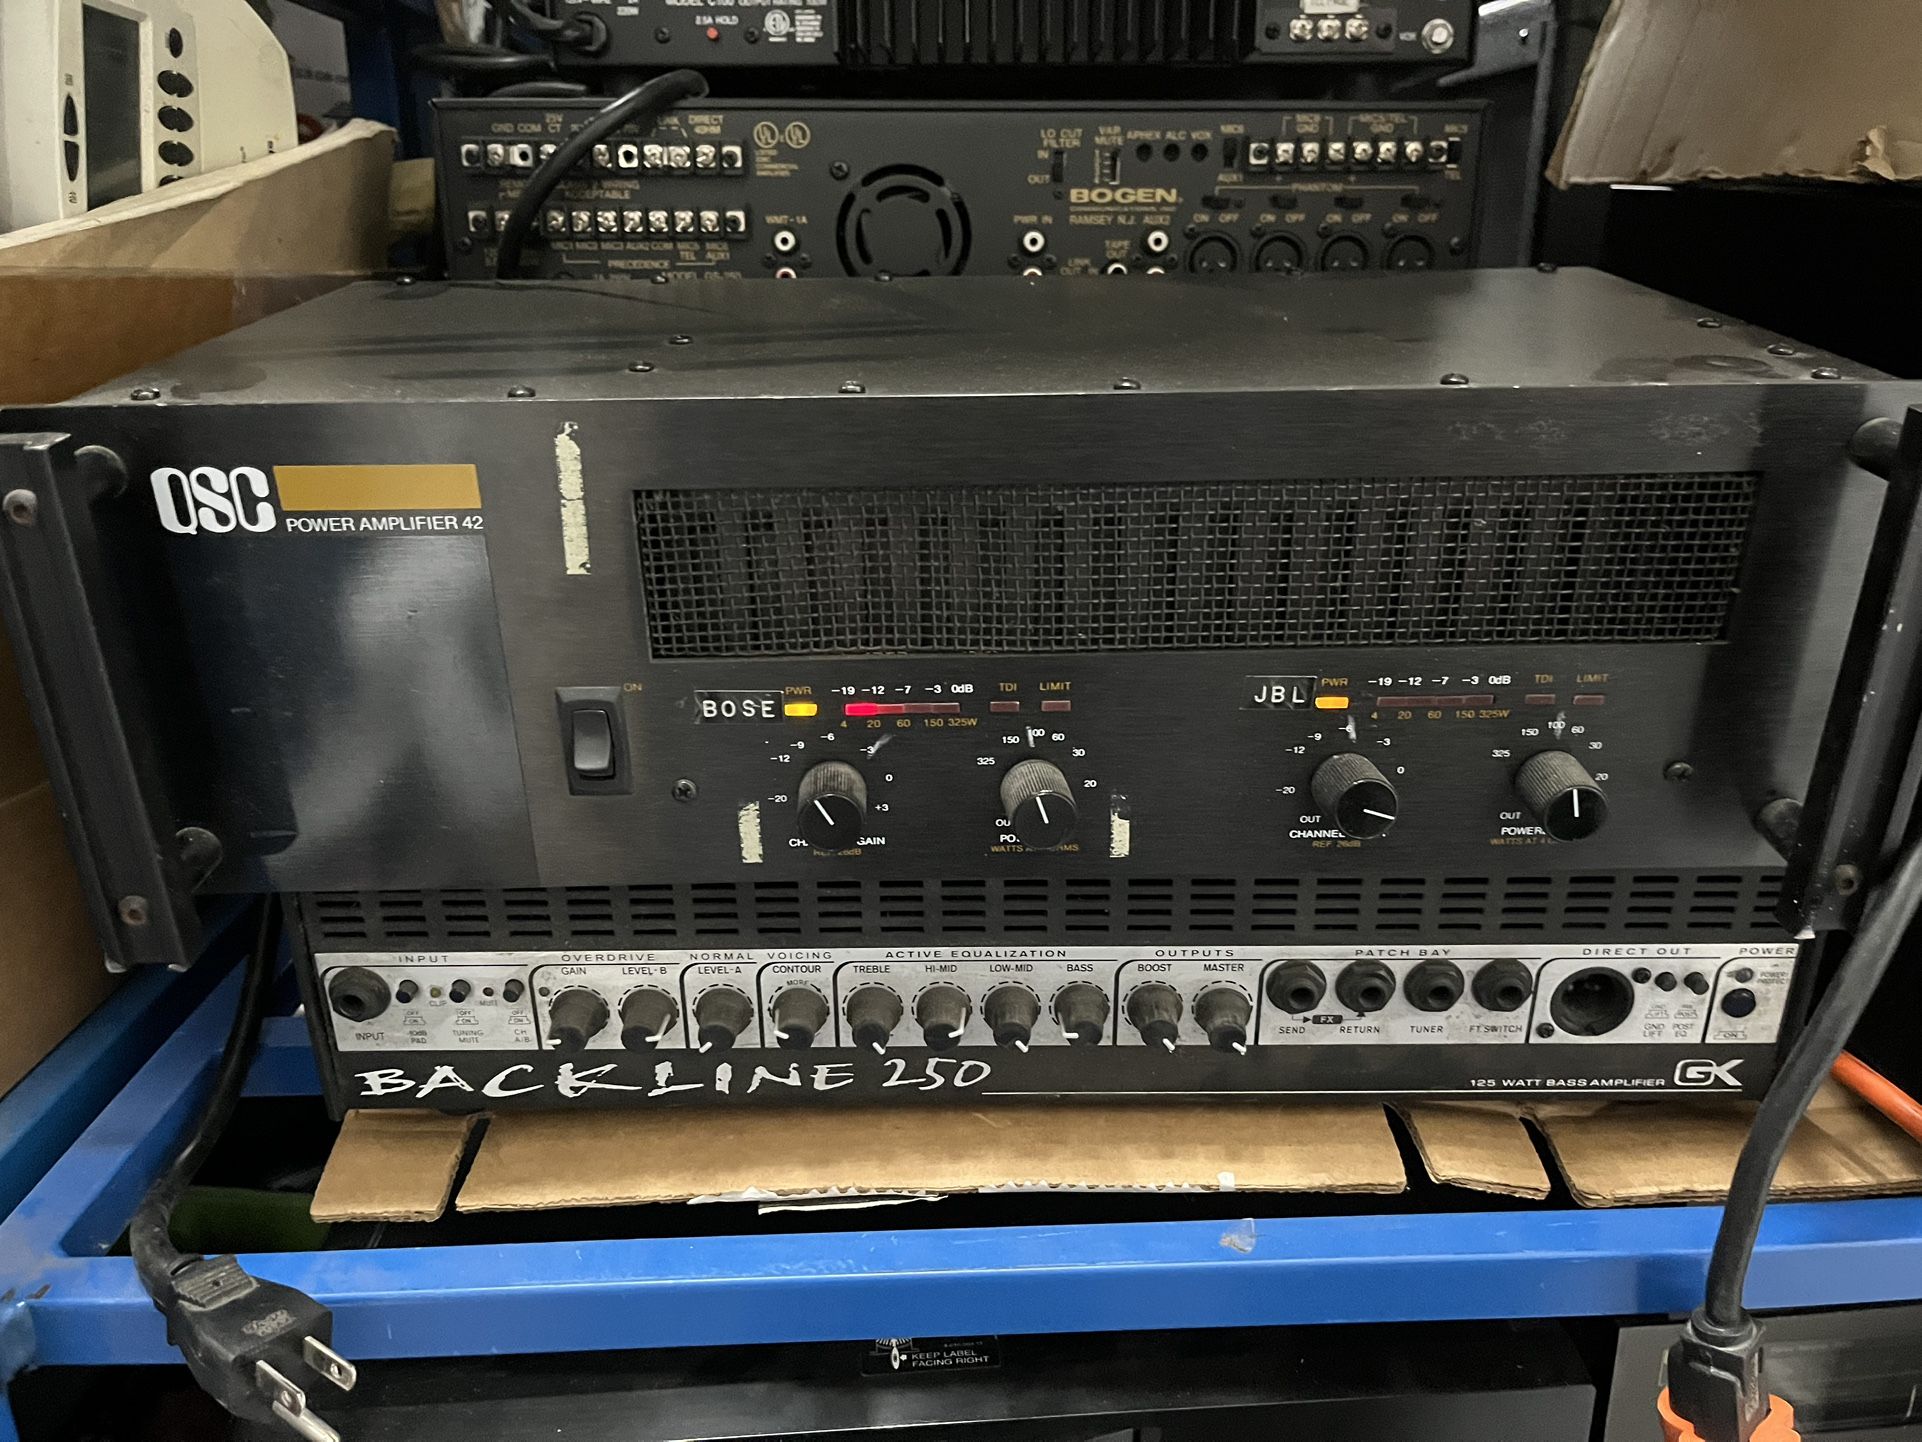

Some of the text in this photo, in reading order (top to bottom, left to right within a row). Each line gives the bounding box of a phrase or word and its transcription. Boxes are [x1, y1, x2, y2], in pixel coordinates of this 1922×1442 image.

[688, 115, 723, 124] DIRECT
[1060, 129, 1083, 138] CUT
[1126, 130, 1161, 140] APHEX
[1165, 130, 1186, 140] ALC
[1042, 138, 1081, 148] FILTER
[1095, 136, 1124, 146] MUTE
[1037, 150, 1049, 159] IN
[1028, 174, 1050, 184] OUT
[1070, 188, 1178, 204] BOGEN
[1042, 214, 1054, 224] IN
[1069, 214, 1113, 225] RAMSEY
[1193, 213, 1239, 223] ON OFF
[1260, 213, 1306, 223] ON OFF
[1326, 213, 1372, 223] ON OFF
[1392, 213, 1439, 223] ON OFF
[151, 466, 277, 535] QSC
[286, 516, 484, 532] POWER AMPLIFIER 42
[1321, 678, 1349, 688] PWR
[1368, 674, 1512, 686] -19 -12 -7 -3 0dB
[1534, 674, 1554, 684] TDI
[1576, 674, 1610, 683] LIMIT
[623, 683, 642, 692] ON
[785, 686, 812, 696] PWR
[831, 684, 974, 695] -19 -12 -7 -3 0dB
[999, 682, 1018, 692] TDI
[1040, 682, 1072, 691] LIMIT
[1254, 686, 1305, 704] JBL
[702, 700, 776, 718] BOSE
[1371, 709, 1511, 720] 4 20 60 150 325W
[867, 720, 881, 728] 20
[896, 720, 911, 728] 60
[924, 718, 944, 728] 150
[948, 718, 978, 728] 325W
[1548, 720, 1566, 730] 100
[1521, 728, 1540, 737] 150
[1571, 725, 1585, 734] 60
[820, 732, 835, 741] -6
[1002, 736, 1020, 744] 150
[1052, 732, 1065, 742] 60
[1307, 732, 1322, 742] -9
[1376, 737, 1392, 746] -3
[790, 740, 805, 750] -9
[1285, 746, 1306, 754] -12
[1589, 741, 1603, 750] 30
[1072, 748, 1086, 758] 30
[1492, 748, 1512, 758] 325
[770, 754, 790, 764] -12
[976, 756, 996, 766] 325
[1396, 766, 1406, 775] 0
[885, 774, 893, 782] 0
[1595, 772, 1609, 782] 20
[1084, 778, 1098, 788] 20
[1275, 786, 1296, 794] -20
[768, 794, 788, 804] -20
[875, 804, 890, 812] +3
[1300, 815, 1322, 824] OUT
[1500, 812, 1522, 820] OUT
[991, 844, 1024, 853] WATTS
[885, 950, 1068, 959] ACTIVE EQUALIZATION
[1154, 949, 1235, 958] OUTPUTS
[1354, 948, 1452, 957] PATCH BAY
[1582, 947, 1692, 956] DIRECT OUT
[1739, 947, 1796, 956] POWER
[399, 955, 449, 964] INPUT
[561, 952, 832, 962] OVERDRIVE NORMAL VOICING
[560, 966, 587, 976] GAIN
[698, 966, 742, 974] LEVEL-A
[772, 965, 822, 974] CONTOUR
[853, 964, 1094, 974] TREBLE HI-MID LOW-MID BASS
[1137, 963, 1245, 973] BOOST MASTER
[786, 979, 810, 987] MORE
[1319, 1015, 1335, 1024] FX
[1279, 1026, 1381, 1034] SEND RETURN
[1410, 1025, 1444, 1034] TUNER
[355, 1032, 386, 1042] INPUT
[1674, 1058, 1745, 1086] GK
[354, 1057, 991, 1098] BACKLINE 250
[1470, 1078, 1666, 1088] 125 WATT BASS AMPLIFIER
[912, 1350, 978, 1360] KEEP LABEL
[912, 1356, 990, 1368] FACING RIGHT
